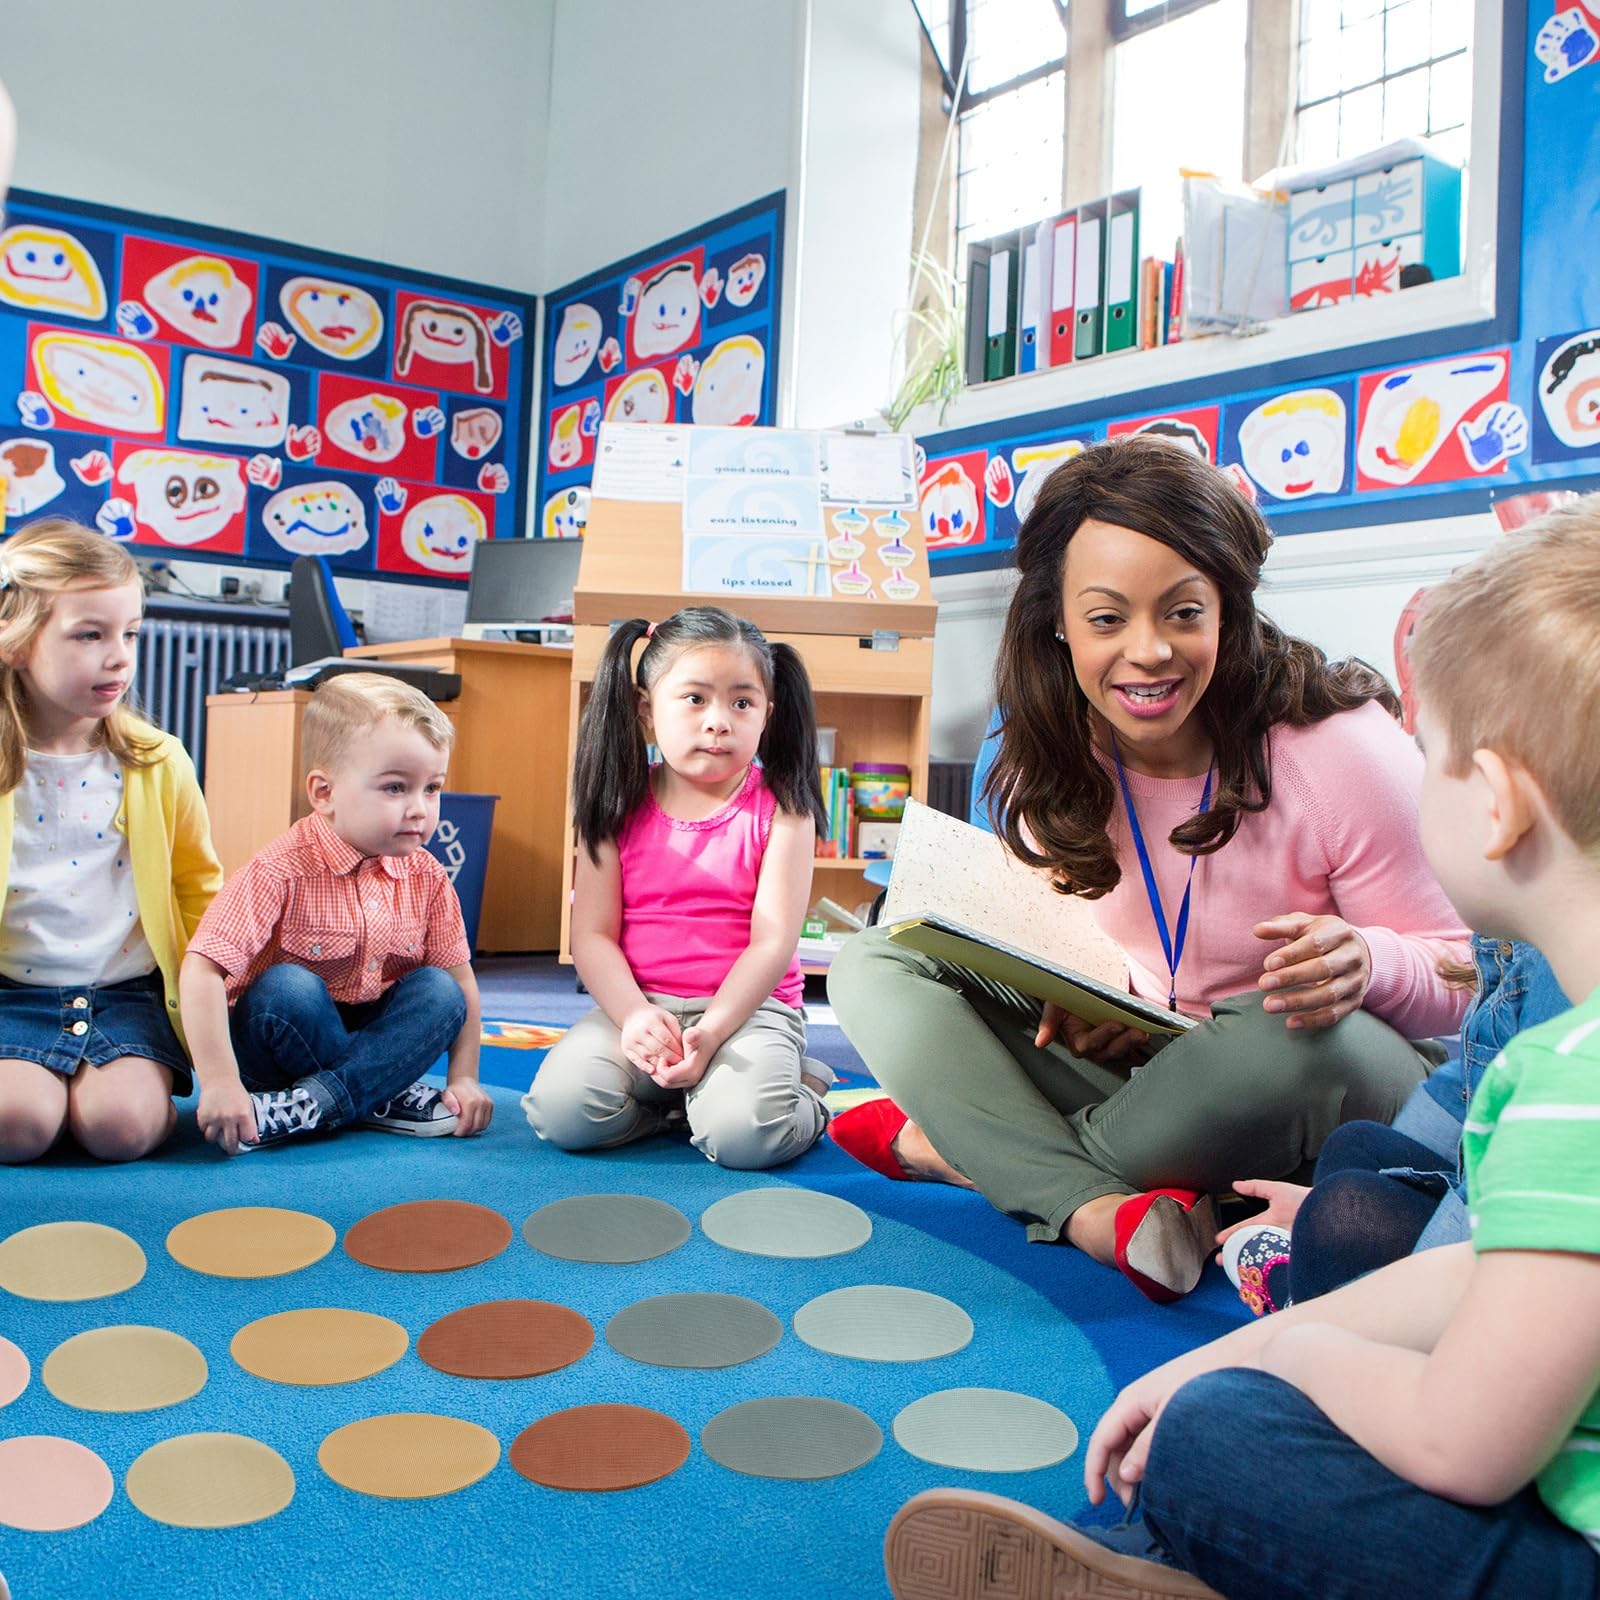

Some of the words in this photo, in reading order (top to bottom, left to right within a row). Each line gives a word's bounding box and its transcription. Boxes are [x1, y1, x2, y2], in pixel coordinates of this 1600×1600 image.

[714, 466, 746, 475] good
[750, 466, 790, 476] sitting
[709, 517, 737, 525] ears
[741, 516, 798, 527] listening
[721, 577, 746, 589] lips
[750, 578, 793, 588] closed
